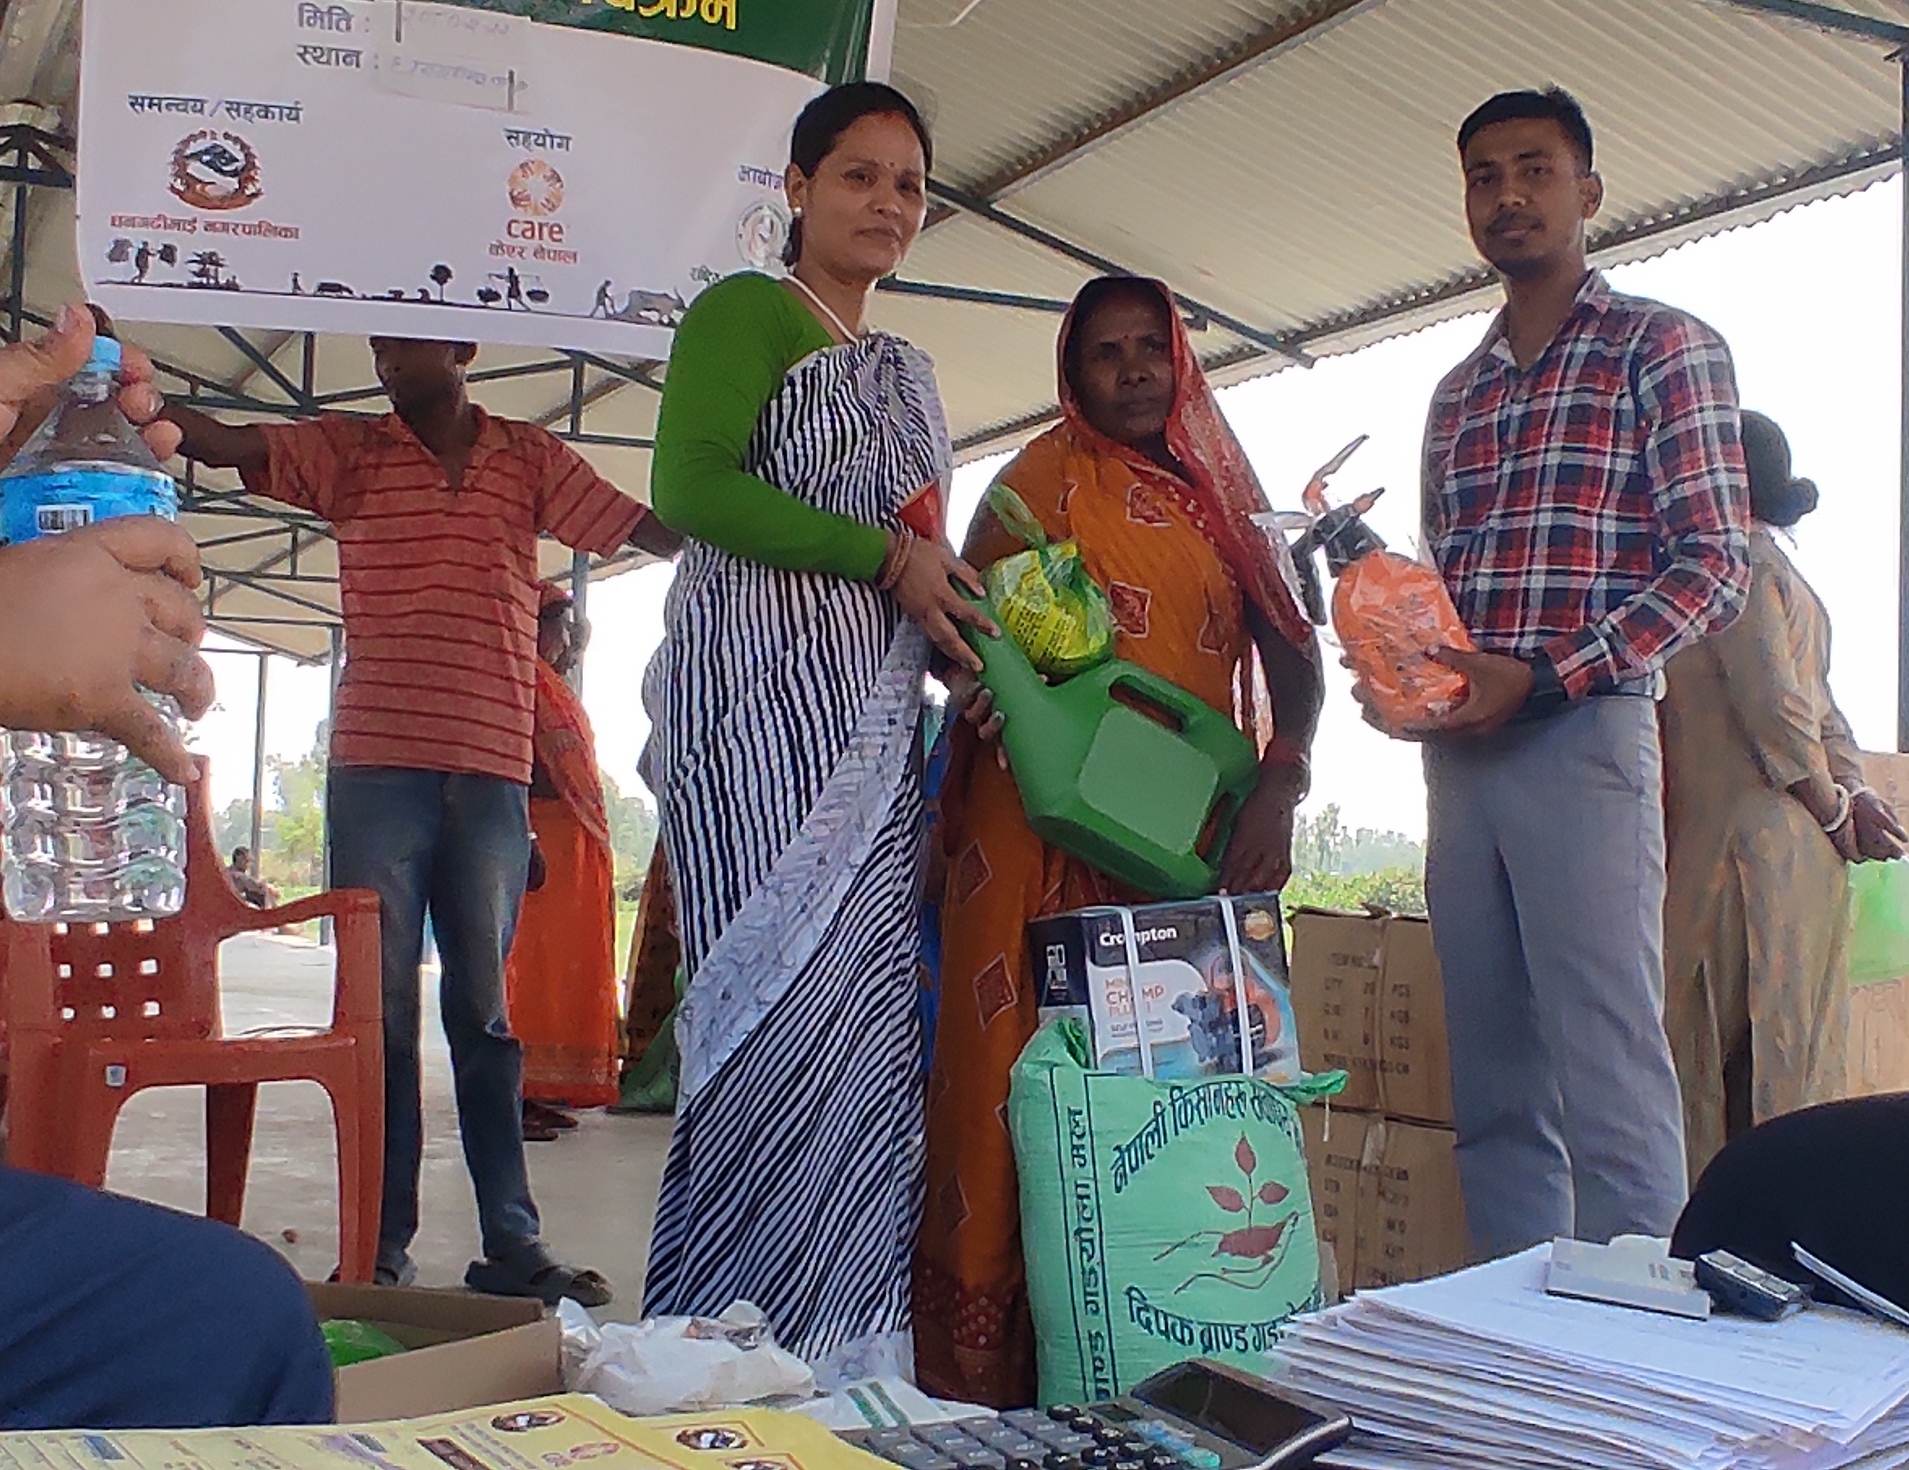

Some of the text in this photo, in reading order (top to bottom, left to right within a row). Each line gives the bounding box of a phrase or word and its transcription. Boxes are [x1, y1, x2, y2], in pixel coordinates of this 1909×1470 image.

[297, 44, 363, 68] स्थान
[504, 128, 572, 151] सहयोग
[203, 219, 300, 239] नगरपालिका
[507, 219, 564, 242] care
[533, 244, 577, 264] नेपाल
[1106, 985, 1165, 1005] CHMP
[1110, 1100, 1168, 1193] नेपाली
[1125, 1286, 1195, 1346] दिपक
